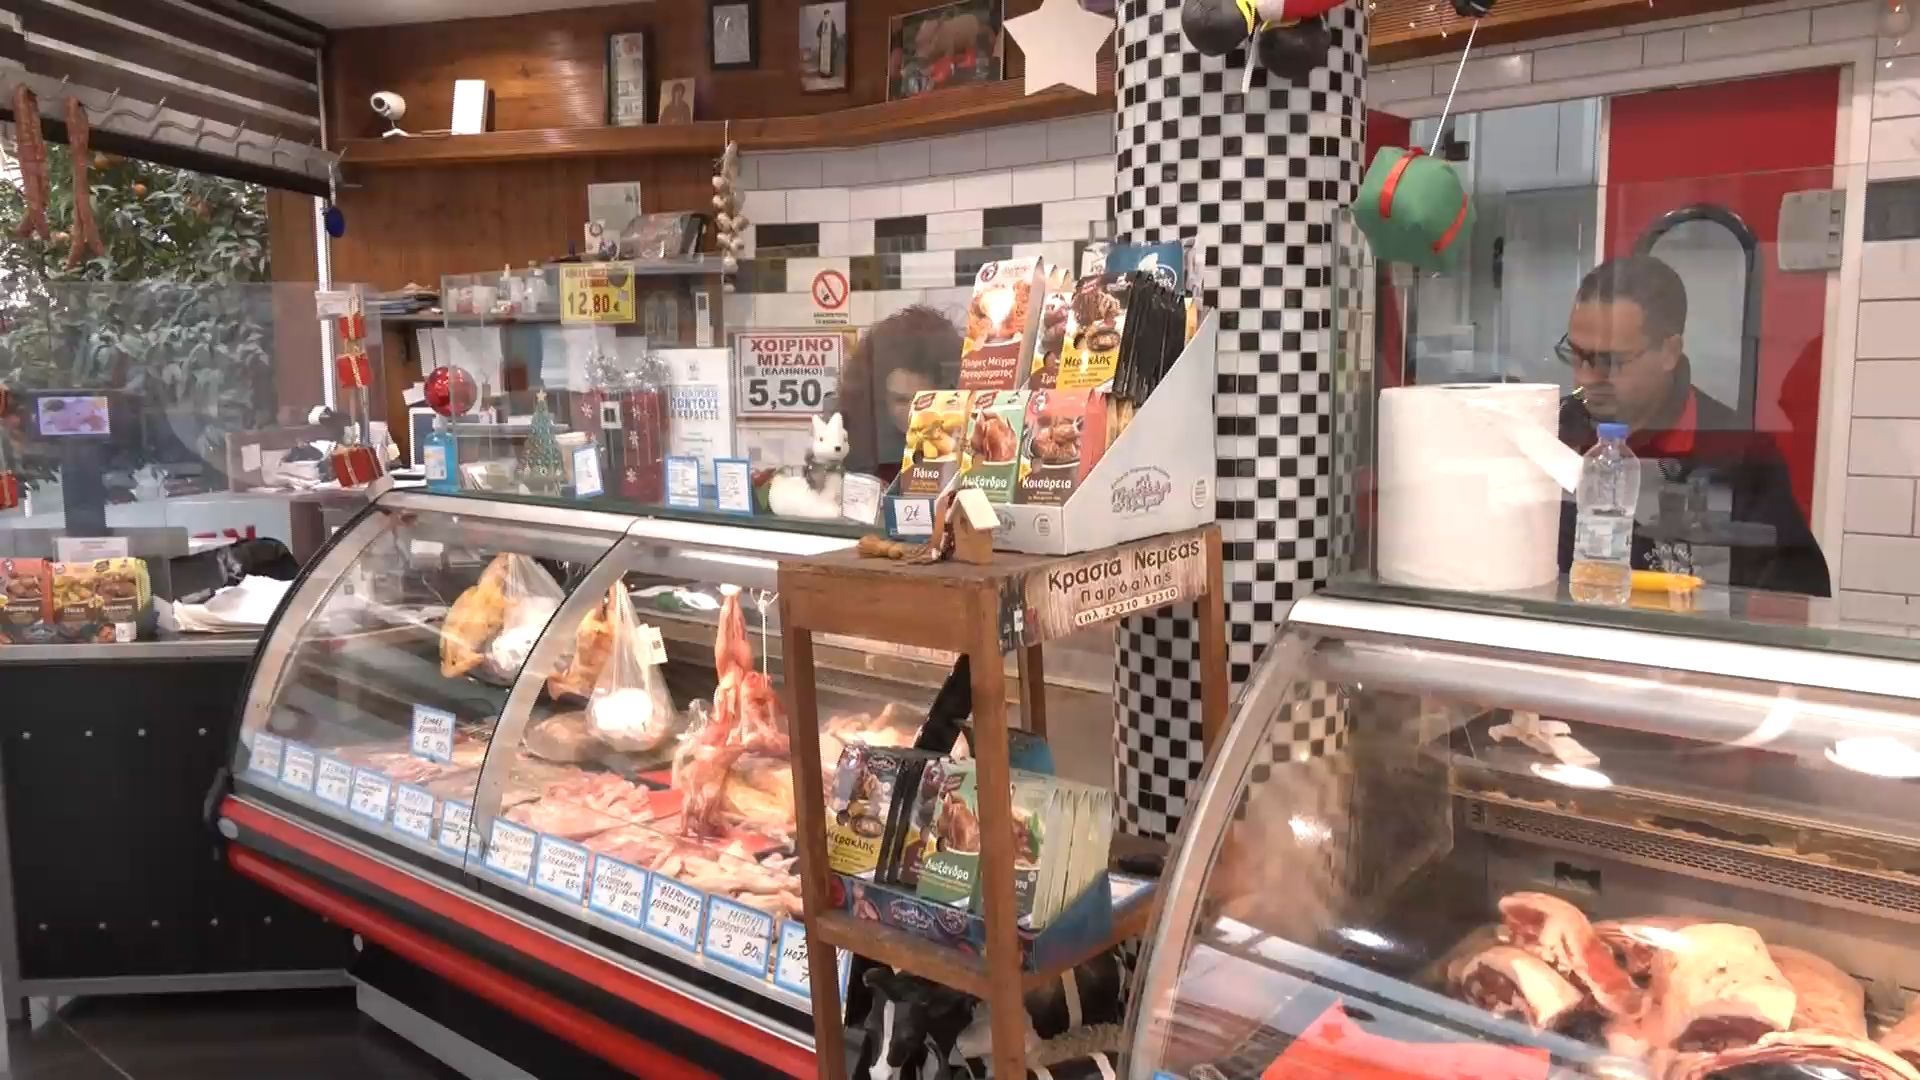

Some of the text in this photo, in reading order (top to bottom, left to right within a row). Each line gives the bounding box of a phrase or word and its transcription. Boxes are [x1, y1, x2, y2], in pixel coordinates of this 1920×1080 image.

[751, 339, 833, 353] ΧΟΙΡΙΝΟ
[757, 353, 826, 367] ΜΙΣΑΔΙ
[761, 367, 824, 377] (ΕΛΛΗΝΙΚΟ)
[1022, 476, 1073, 491] Καισάρεια
[1135, 540, 1200, 571] Νεμέας
[721, 933, 732, 949] 3
